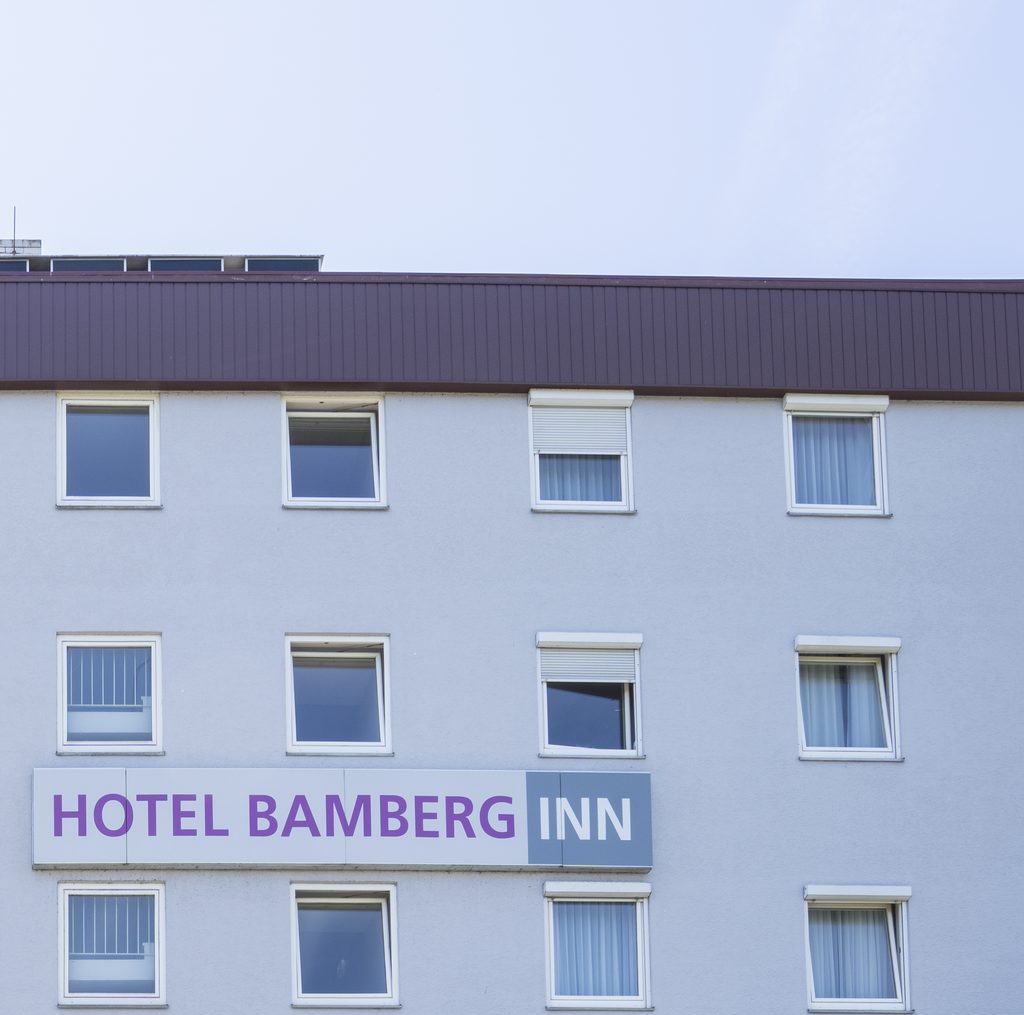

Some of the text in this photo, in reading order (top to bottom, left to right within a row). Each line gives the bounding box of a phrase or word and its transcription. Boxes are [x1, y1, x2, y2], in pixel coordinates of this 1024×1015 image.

[53, 793, 632, 841] HOTEL BAMBERG INN
